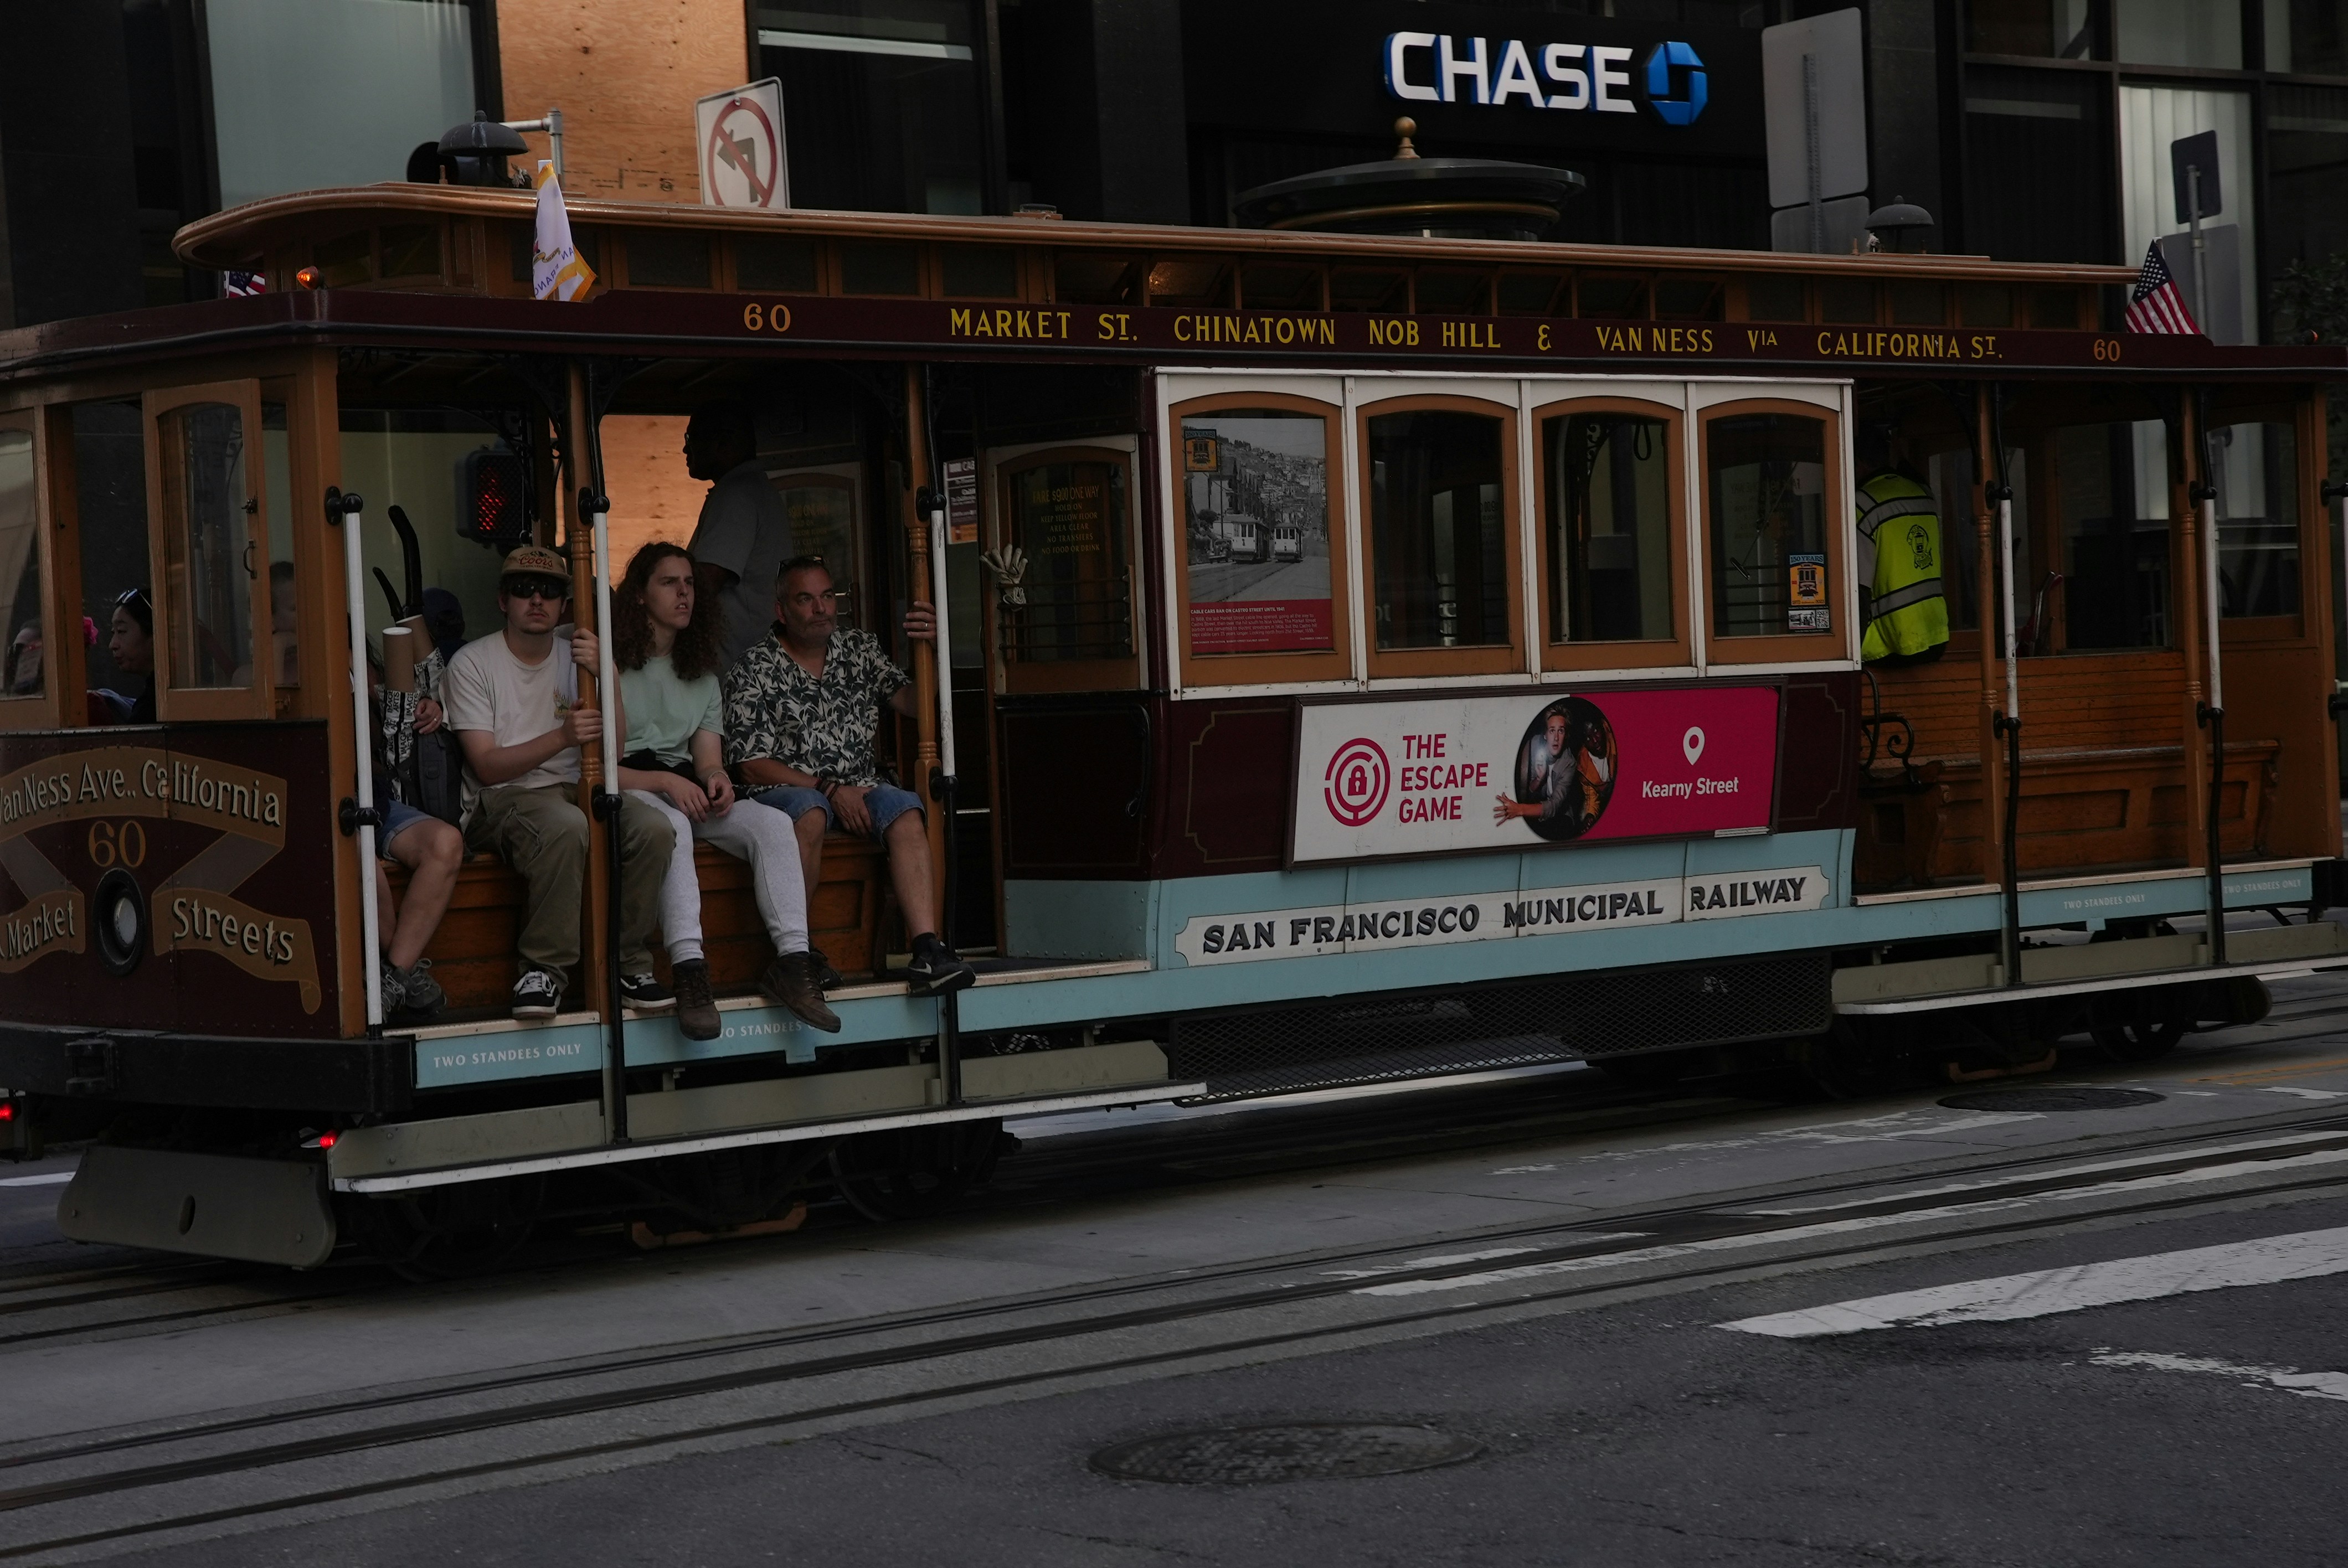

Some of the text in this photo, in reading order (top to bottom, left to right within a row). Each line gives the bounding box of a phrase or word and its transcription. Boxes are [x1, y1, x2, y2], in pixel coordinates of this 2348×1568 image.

[1386, 30, 1638, 114] CHASE
[743, 303, 791, 333] 60
[950, 308, 1071, 339] MARKET
[1098, 313, 1139, 342] ST.
[1173, 315, 1336, 345] CHINATOWN
[1368, 319, 1420, 347] NOB
[1442, 322, 1501, 349] HILL
[1537, 324, 1552, 352] &
[1595, 327, 1642, 352] VAN
[1652, 328, 1714, 353] NESS
[1817, 332, 1961, 359] CALIFORNIA
[1971, 336, 2003, 360] ST.
[2093, 338, 2122, 363] 60
[1070, 486, 1084, 500] ONE
[1084, 485, 1099, 498] WAY
[1055, 504, 1072, 512] HOLD
[1055, 513, 1078, 522] YELLOW
[1079, 512, 1099, 520] FLOOR
[1058, 533, 1094, 542] TRANSFERS
[1069, 522, 1089, 531] CLEAR
[520, 555, 553, 568] Coors
[1052, 545, 1069, 554] FOOD
[1081, 544, 1100, 552] DRINK
[1403, 734, 1446, 759] THE
[1401, 763, 1489, 791] ESCAPE
[1642, 776, 1739, 800] Kearny Street
[23, 773, 71, 816] Ness
[141, 759, 281, 828] California
[1399, 796, 1463, 823] GAME
[88, 819, 147, 868] 60
[2223, 885, 2241, 894] TWO
[2243, 881, 2280, 893] STANDEES
[2063, 894, 2145, 909] TWO STANDEES ONLY
[1203, 877, 1807, 955] SAN FRANCISCO MUNICIPAL RAILWAY
[7, 897, 294, 966] Market Streets
[740, 1022, 802, 1037] STANDEES
[433, 1043, 581, 1068] TWO STANDEES ONLY
